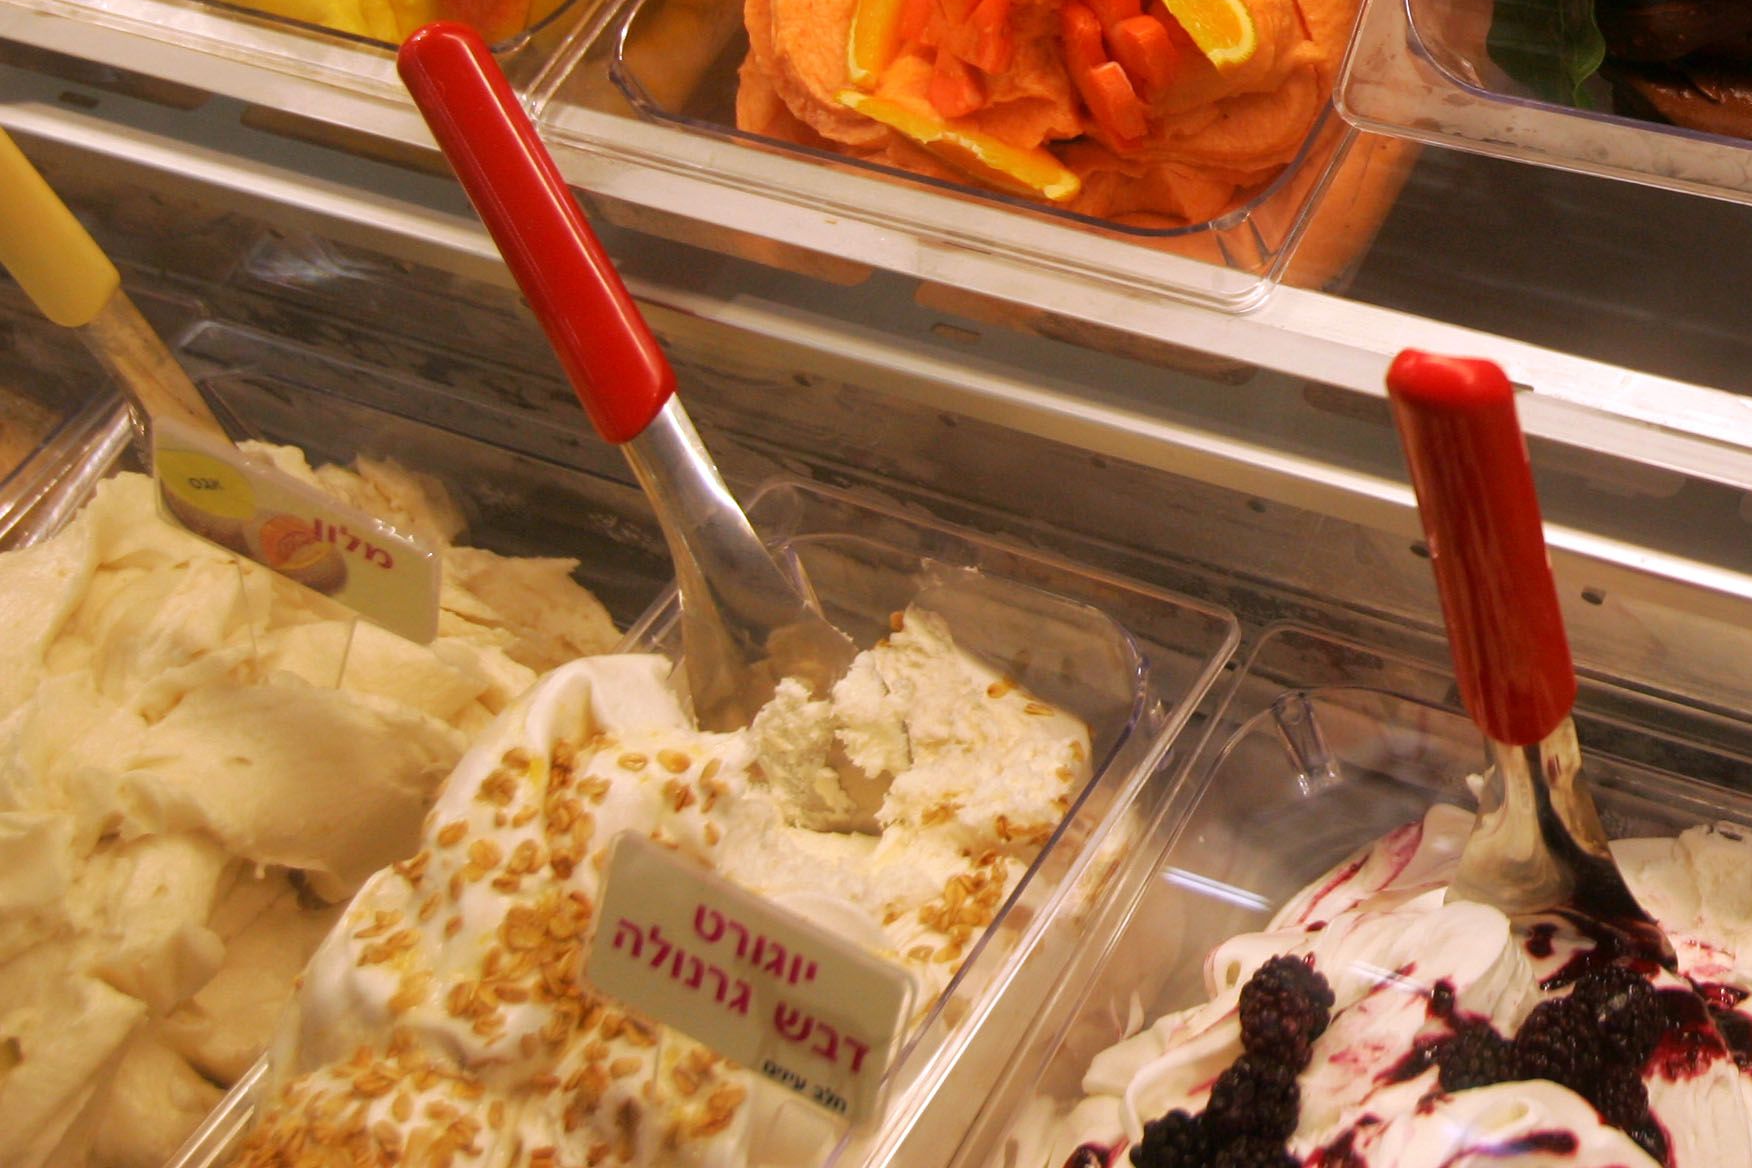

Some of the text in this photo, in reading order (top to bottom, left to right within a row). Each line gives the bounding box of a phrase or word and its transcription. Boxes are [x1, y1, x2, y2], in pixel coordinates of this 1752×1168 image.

[314, 517, 394, 569] מלון
[693, 904, 817, 985] יוגורט
[612, 917, 872, 1074] דבש גרנולה
[813, 1084, 848, 1113] חלב
